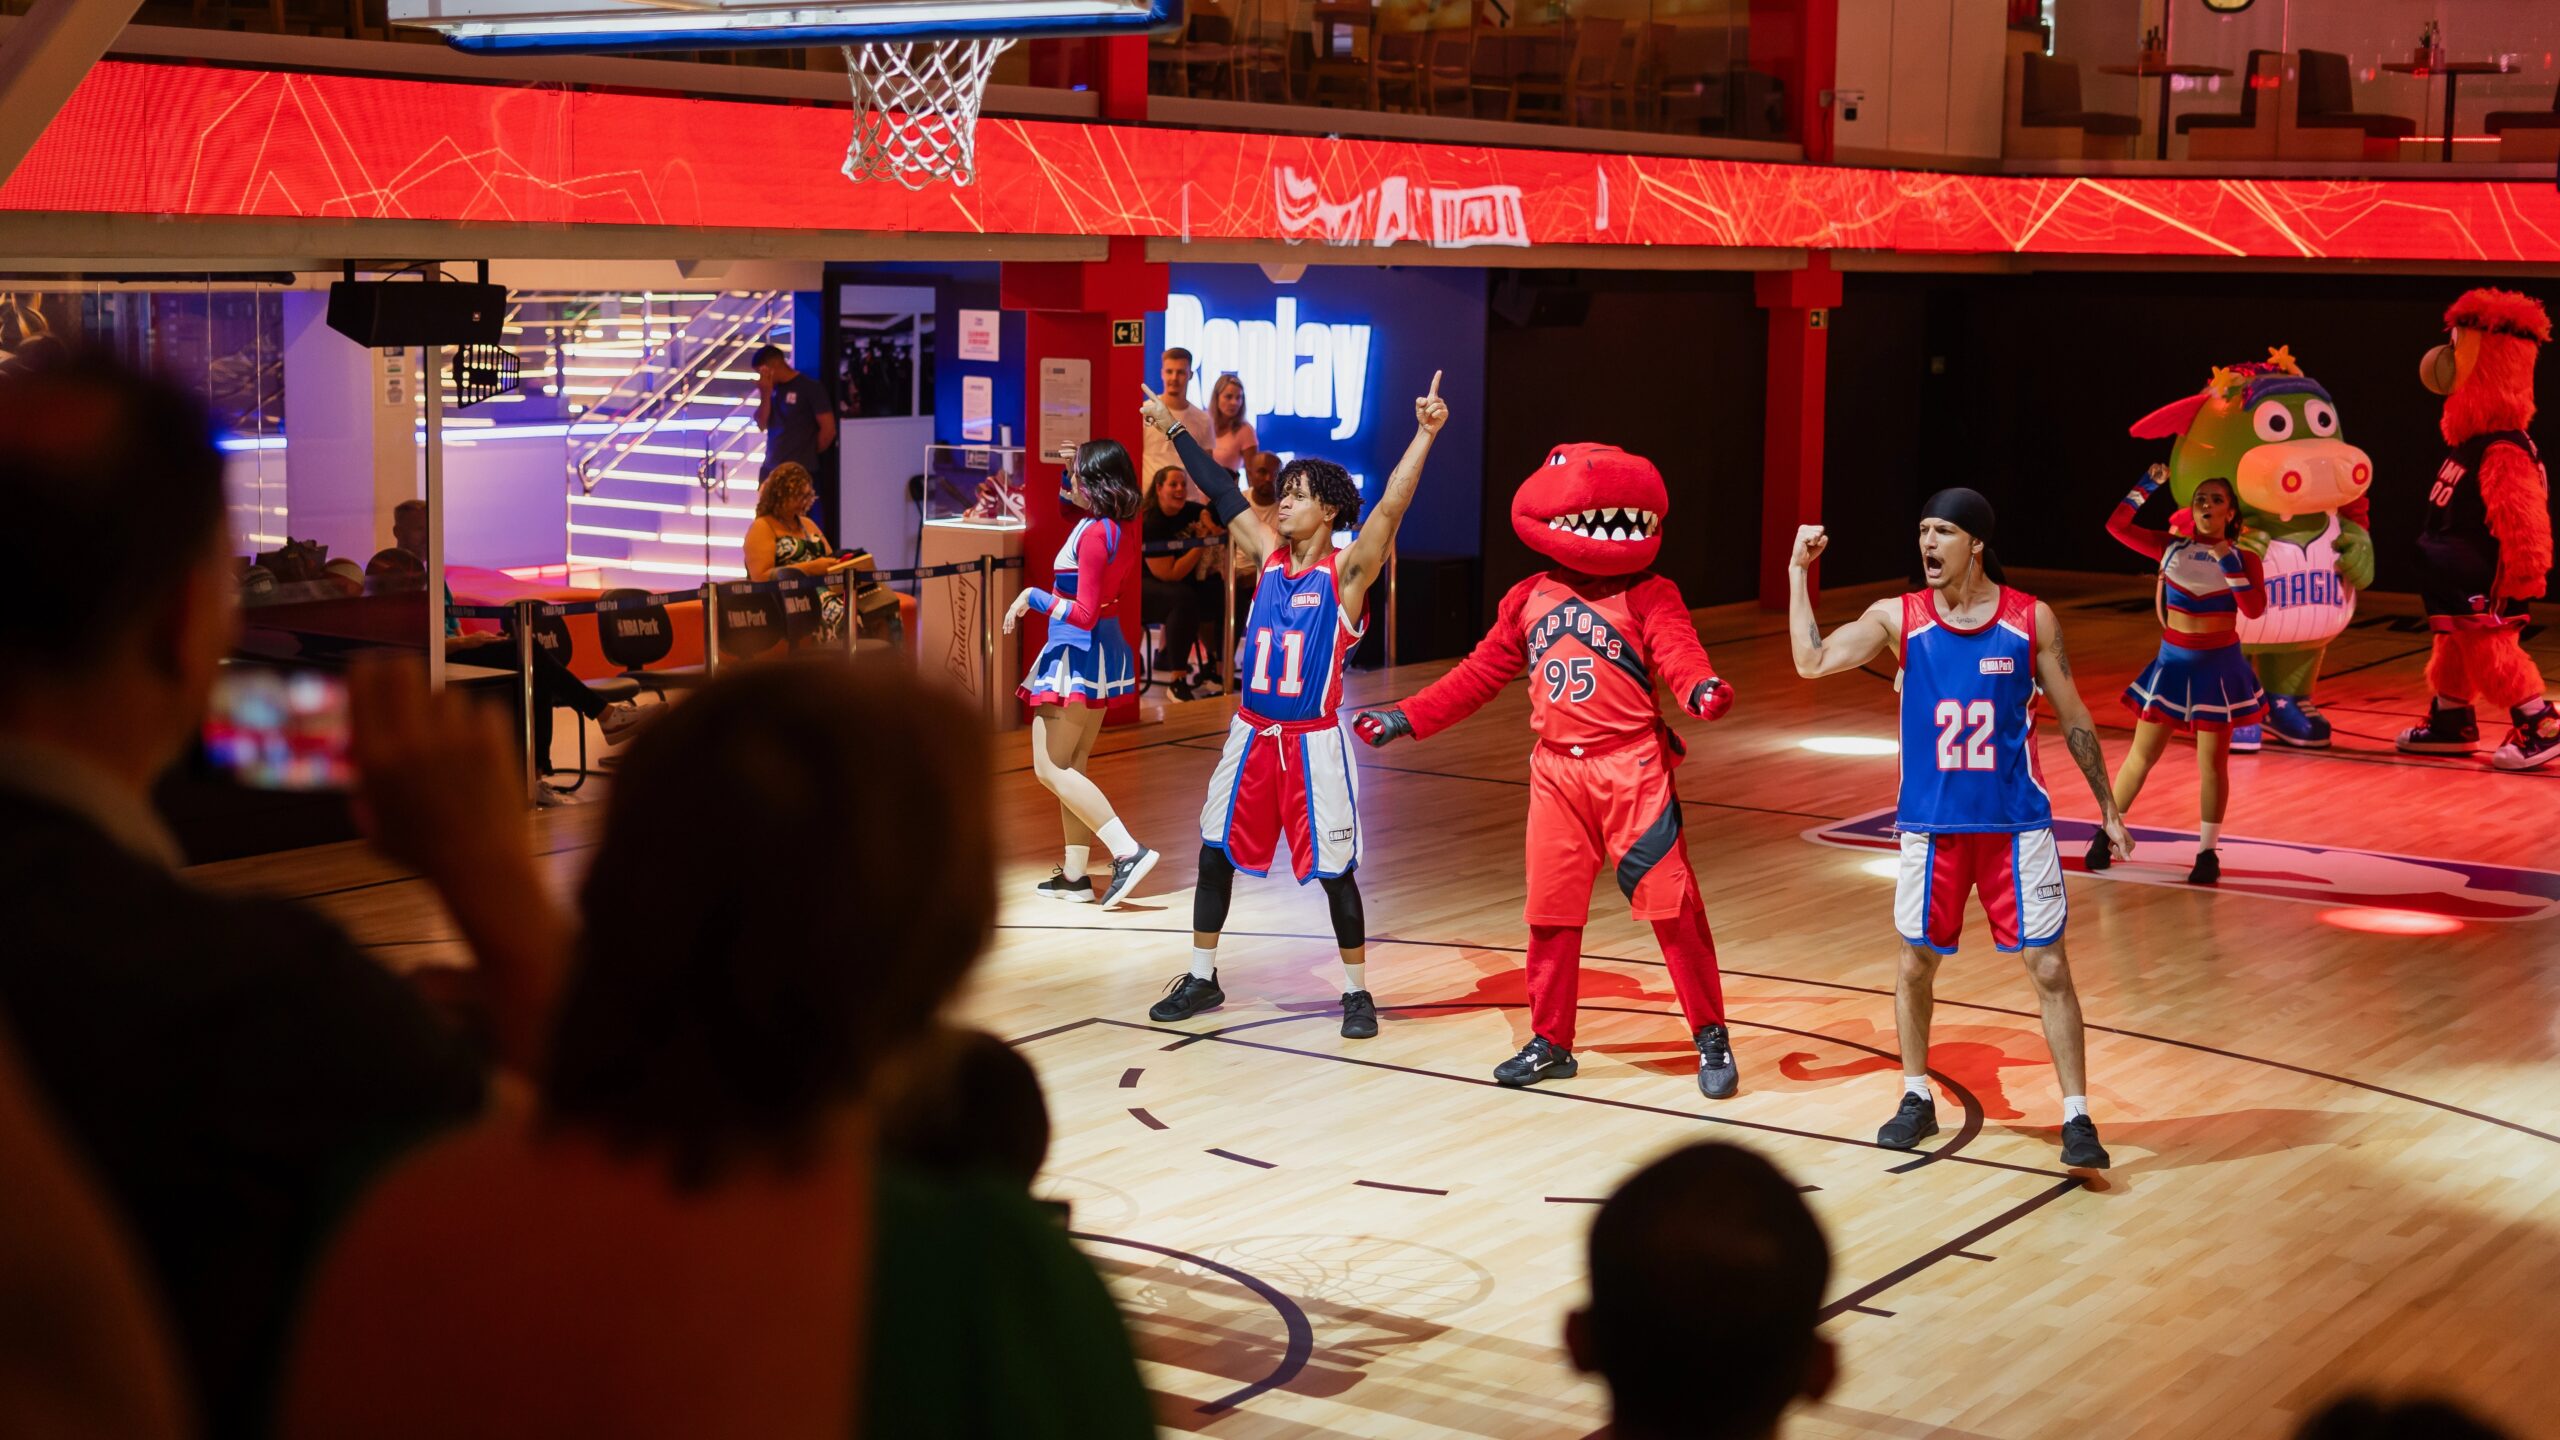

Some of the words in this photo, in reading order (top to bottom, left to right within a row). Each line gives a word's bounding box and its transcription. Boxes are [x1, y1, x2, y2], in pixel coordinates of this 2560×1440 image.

[1165, 294, 1371, 440] Replay
[2264, 569, 2344, 610] MAGIC
[639, 617, 660, 635] Park
[953, 574, 967, 683] Budweiser
[1529, 607, 1622, 663] RAPTORS
[1249, 628, 1303, 695] 11
[1544, 657, 1596, 703] 95
[1935, 700, 1996, 770] 22
